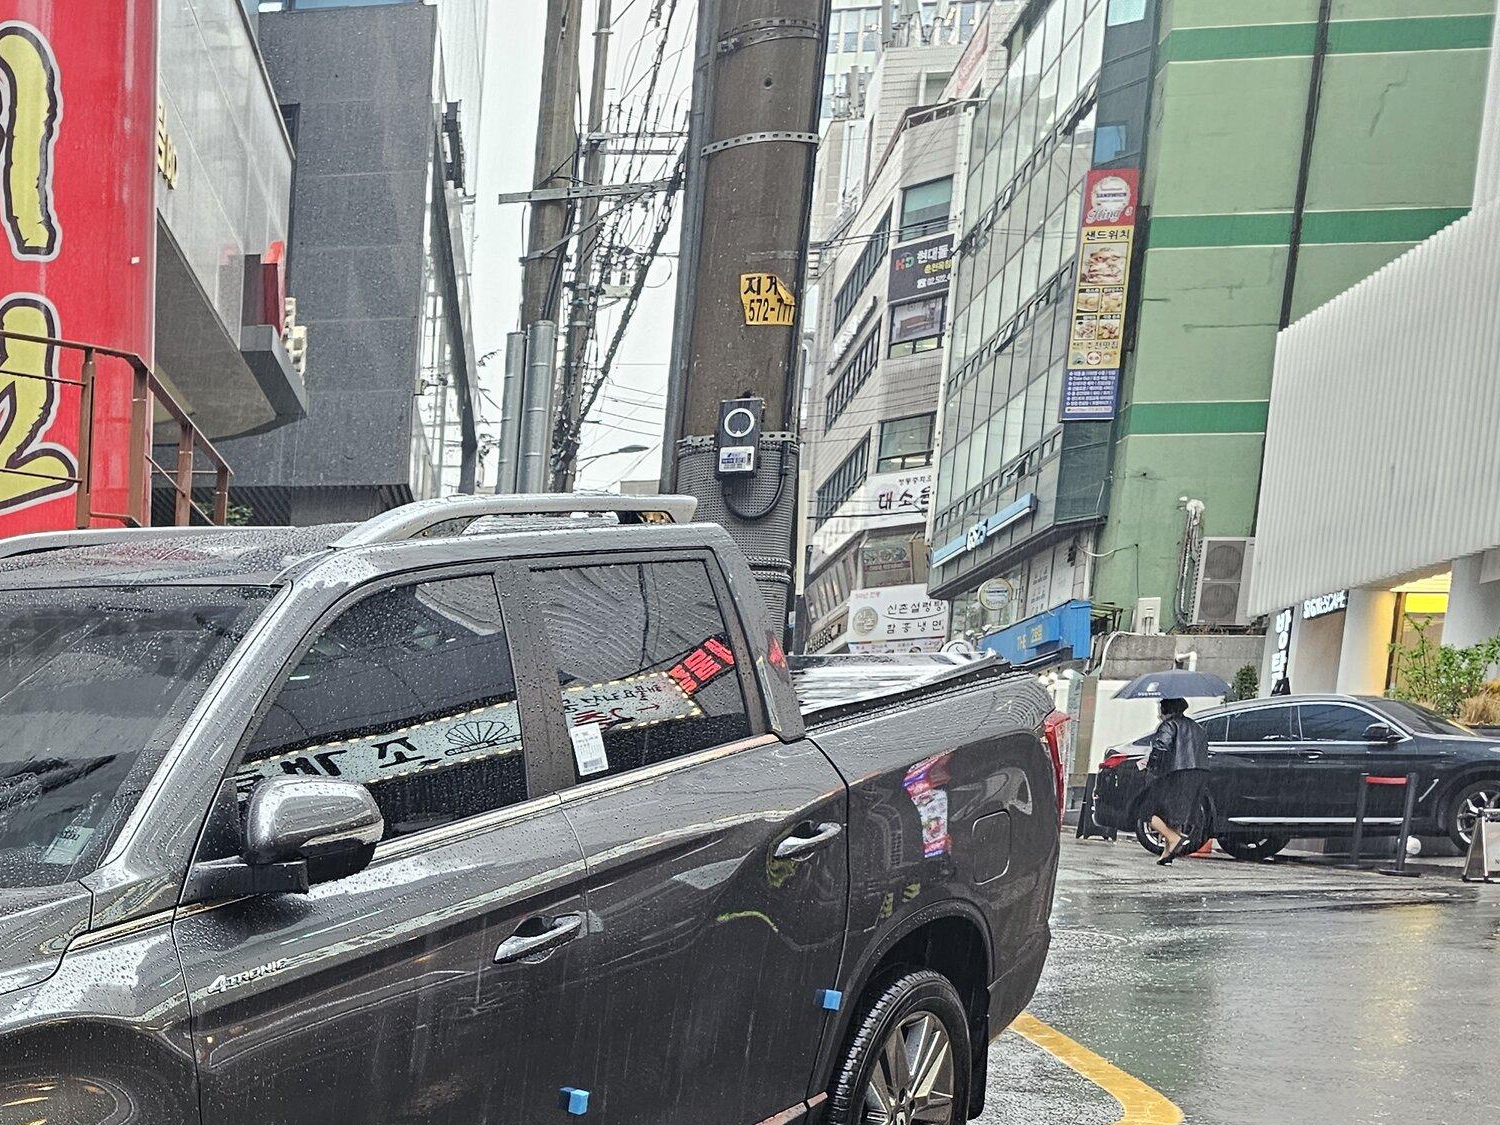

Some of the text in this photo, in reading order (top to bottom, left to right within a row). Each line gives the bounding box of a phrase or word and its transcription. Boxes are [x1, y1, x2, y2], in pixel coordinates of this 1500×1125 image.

[1085, 229, 1130, 241] 샌드위치
[916, 244, 954, 264] 현대돌
[886, 600, 944, 616] 신촌설렁탕
[206, 957, 289, 994] 4TRONIC
